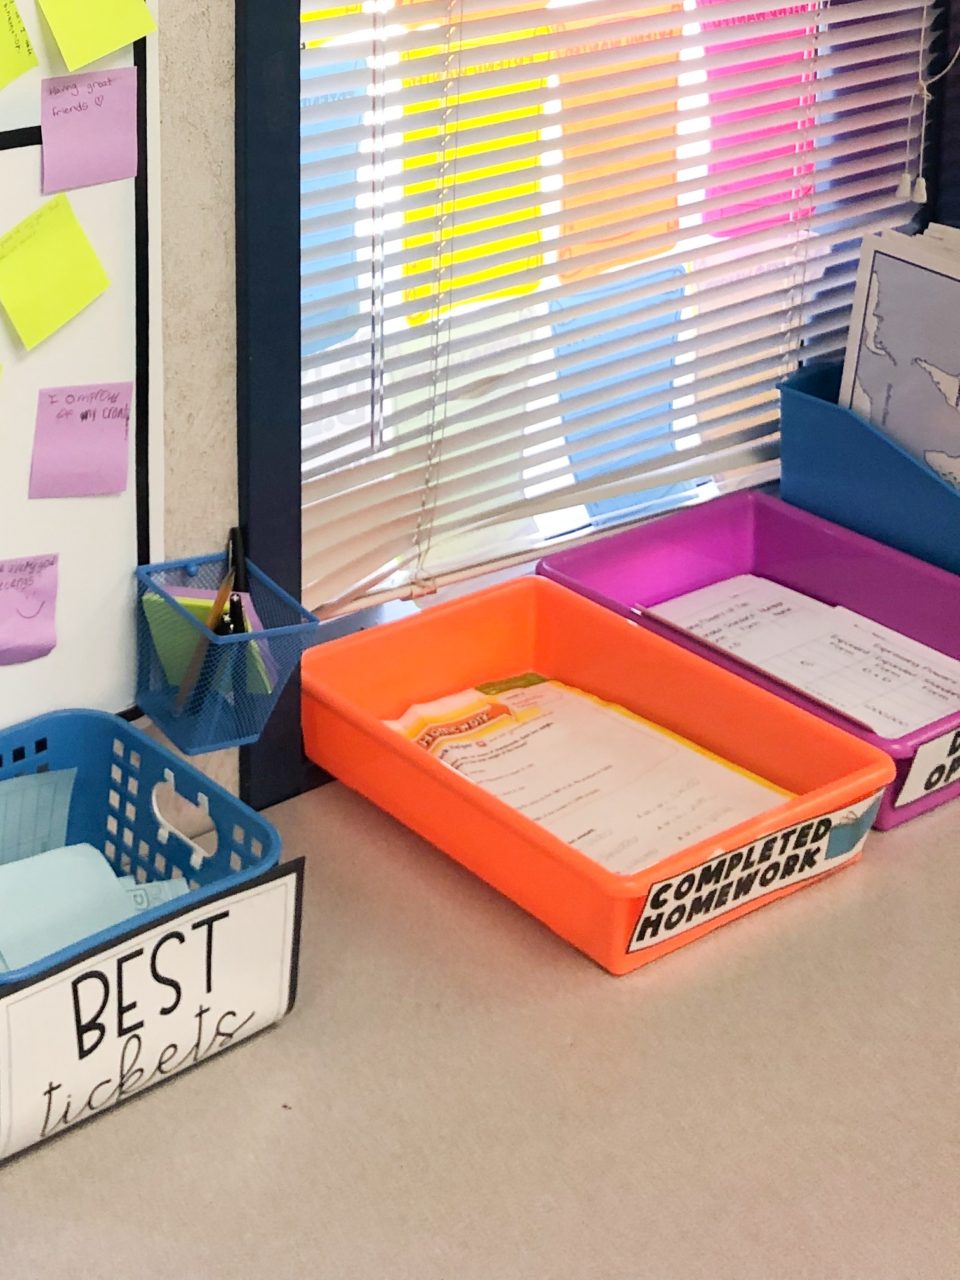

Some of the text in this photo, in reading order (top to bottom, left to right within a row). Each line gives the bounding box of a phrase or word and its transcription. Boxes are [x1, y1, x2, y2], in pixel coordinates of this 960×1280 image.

[636, 847, 820, 942] HOMEWORK
[650, 818, 832, 910] COMPLETED
[72, 911, 229, 1060] BEST
[40, 1004, 256, 1137] tickets
